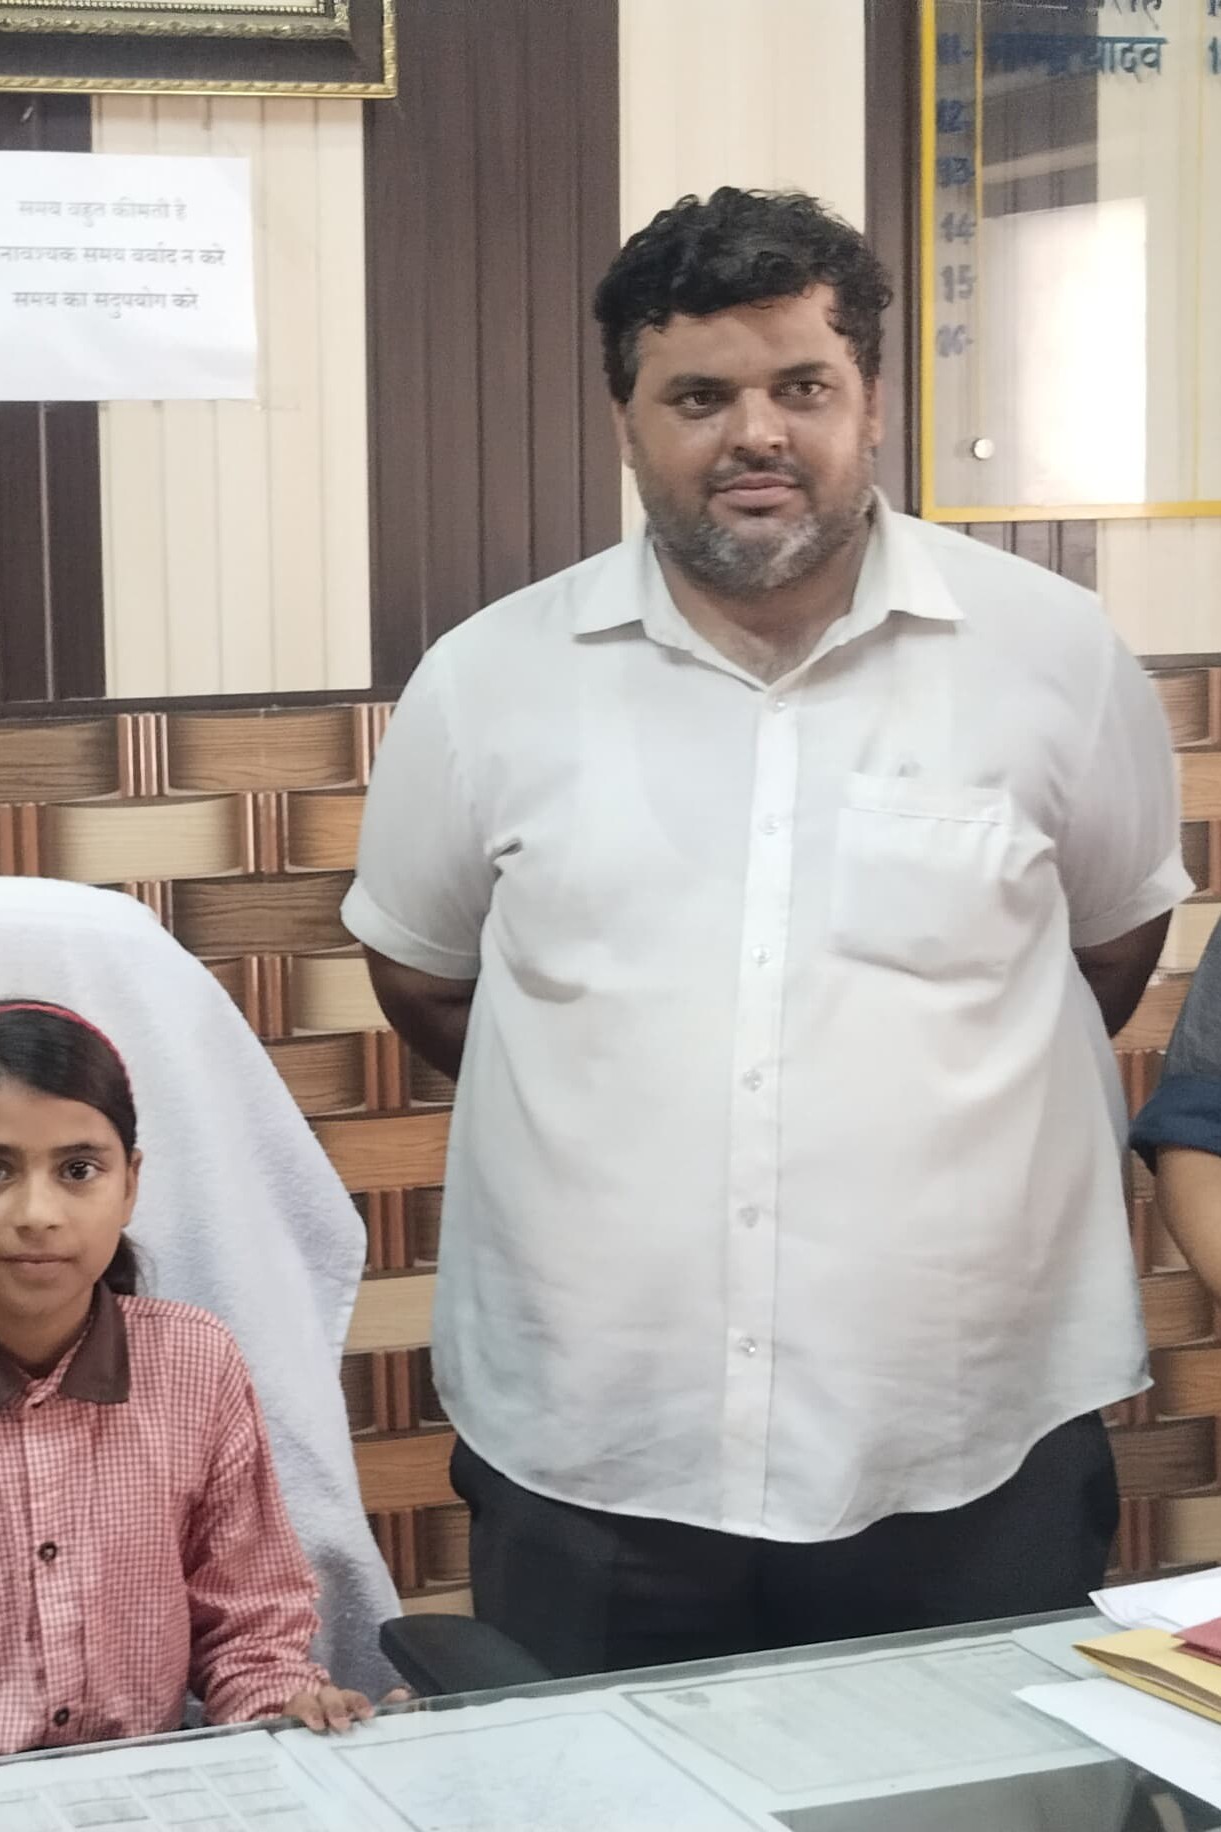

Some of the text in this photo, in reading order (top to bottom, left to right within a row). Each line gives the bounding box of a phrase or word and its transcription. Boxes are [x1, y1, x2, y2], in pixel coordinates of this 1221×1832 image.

[17, 200, 62, 217] समय
[81, 247, 126, 262] समय
[181, 248, 195, 264] न
[12, 291, 59, 307] समय
[61, 291, 88, 307] का
